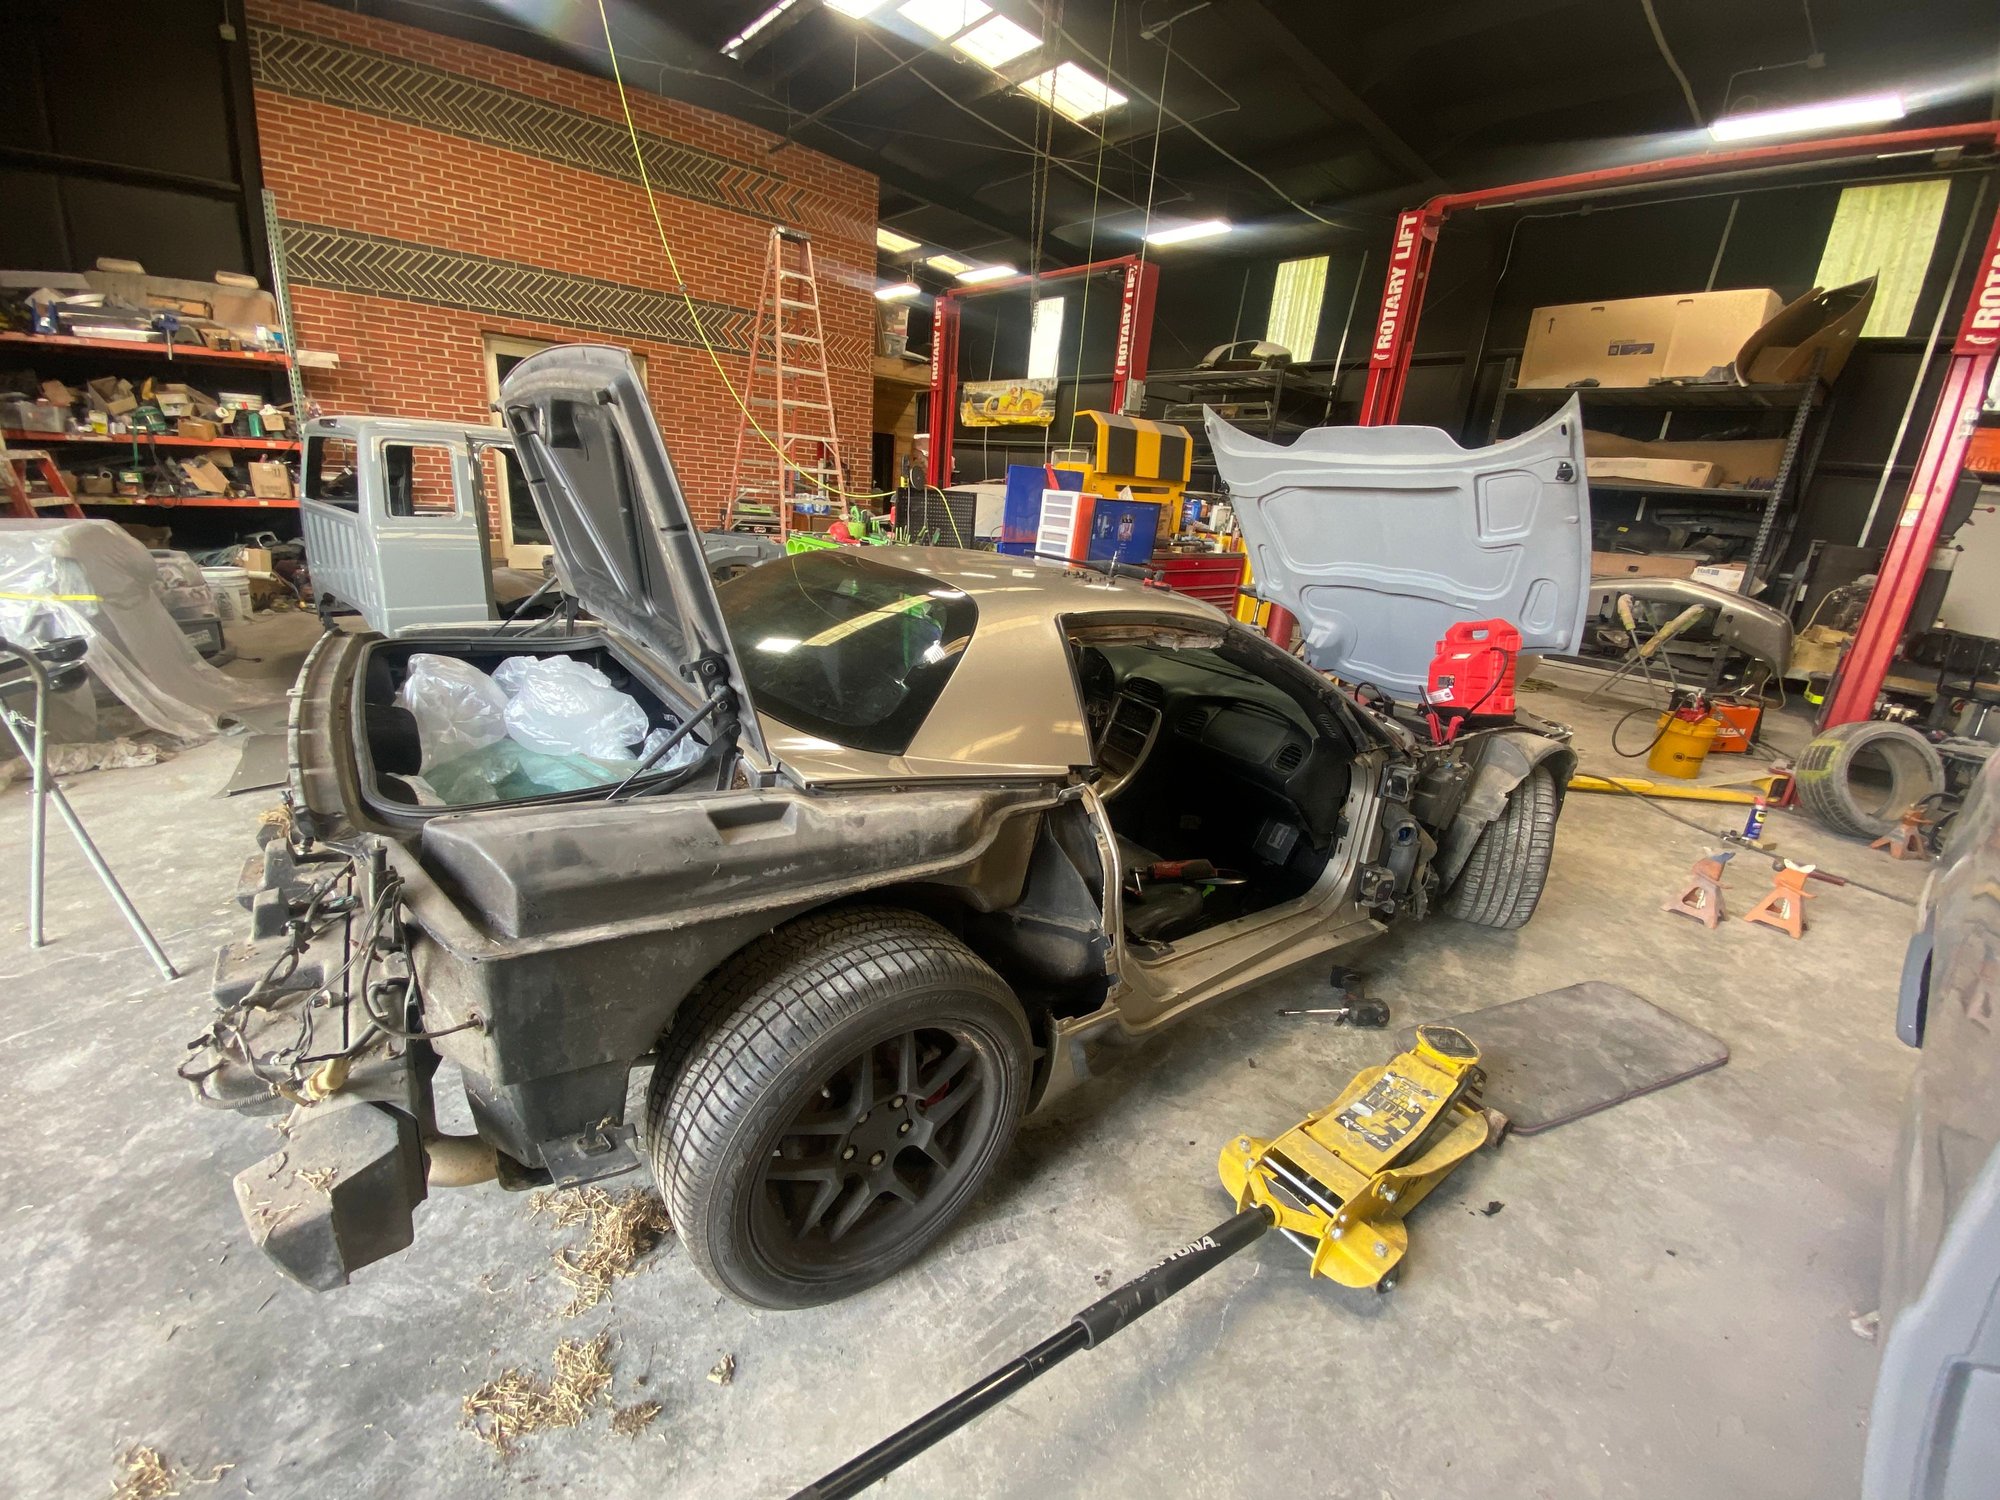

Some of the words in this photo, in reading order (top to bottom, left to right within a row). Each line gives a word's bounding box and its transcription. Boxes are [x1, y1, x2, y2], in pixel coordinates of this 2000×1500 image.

[1377, 267, 1407, 349] ROTARY
[1395, 215, 1418, 260] LIFT
[934, 300, 943, 327] LIFT
[1117, 303, 1132, 366] ROTARY
[932, 330, 941, 380] ROTARY
